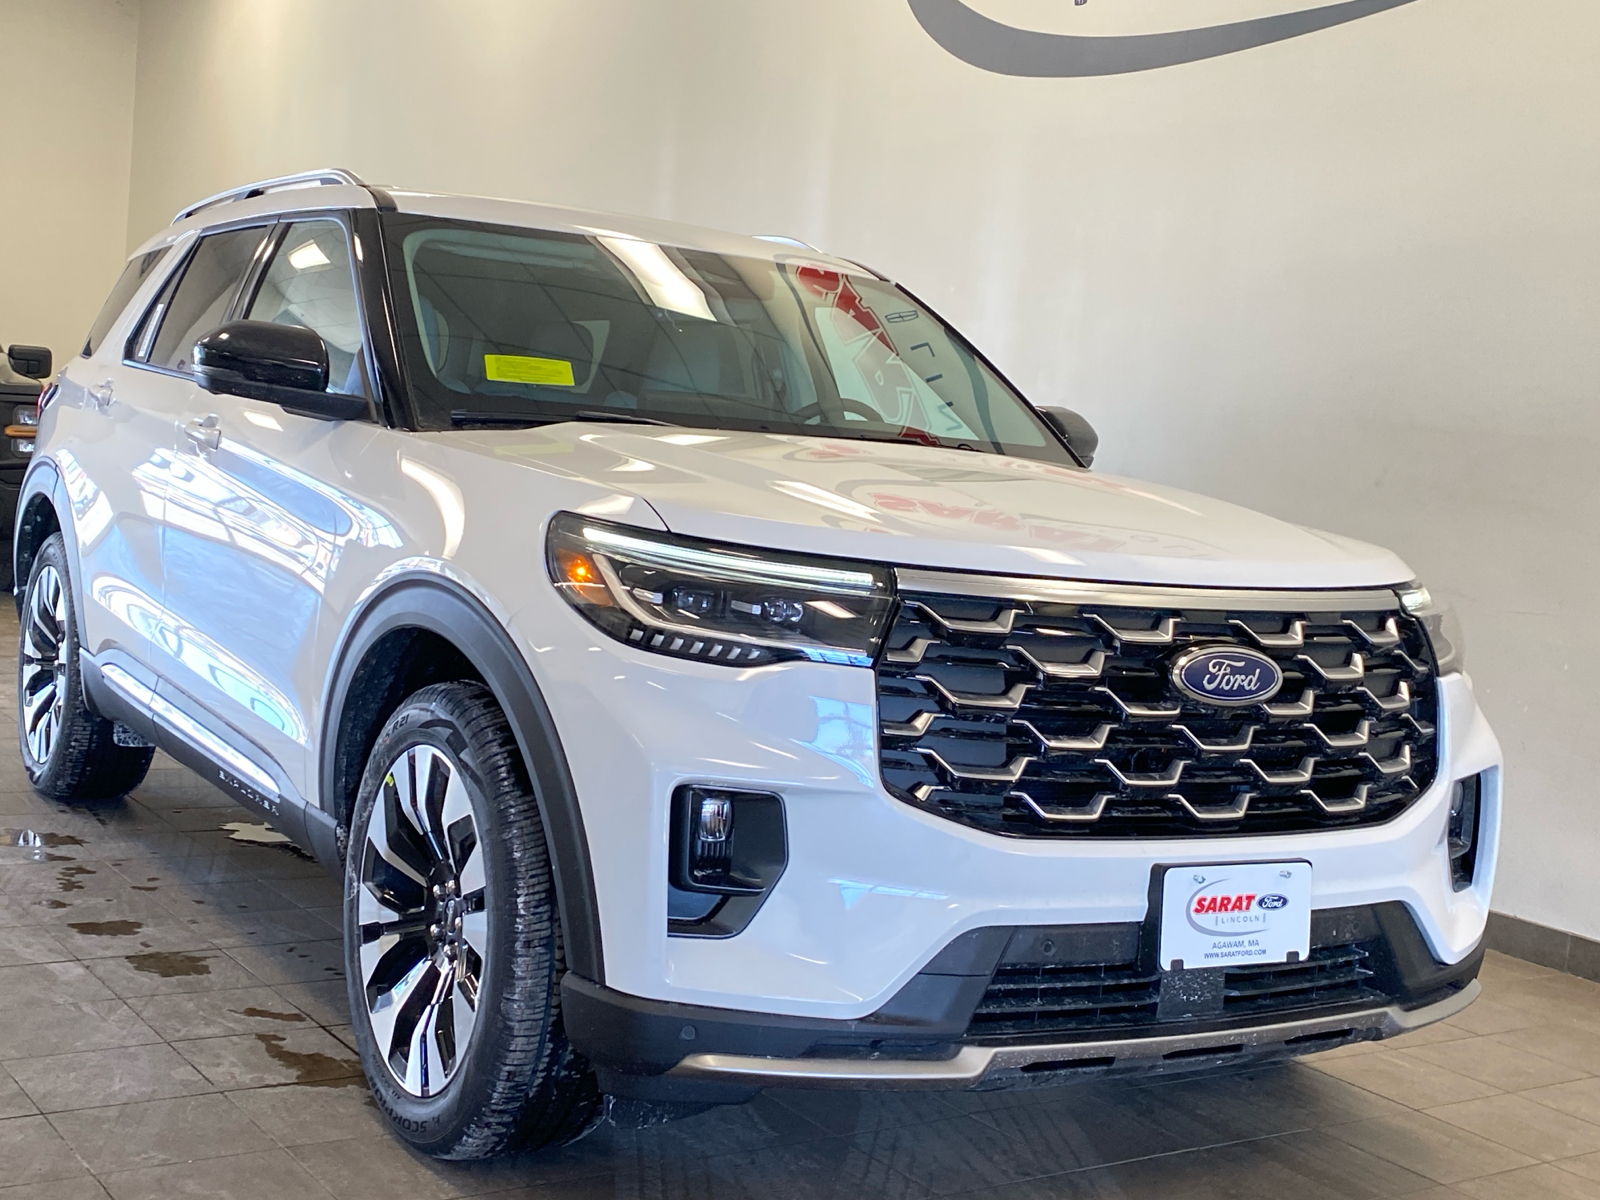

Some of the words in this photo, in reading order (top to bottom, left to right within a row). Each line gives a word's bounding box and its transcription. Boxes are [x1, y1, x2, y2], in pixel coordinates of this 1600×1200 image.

[1203, 659, 1260, 690] Ford
[1194, 894, 1256, 914] SARAT
[1262, 896, 1283, 908] Ford
[1221, 915, 1260, 924] LINCOLN
[1212, 940, 1246, 950] AGAWAM,
[1248, 939, 1260, 947] MA
[1204, 949, 1267, 959] WWW.SARATFORD.COM
